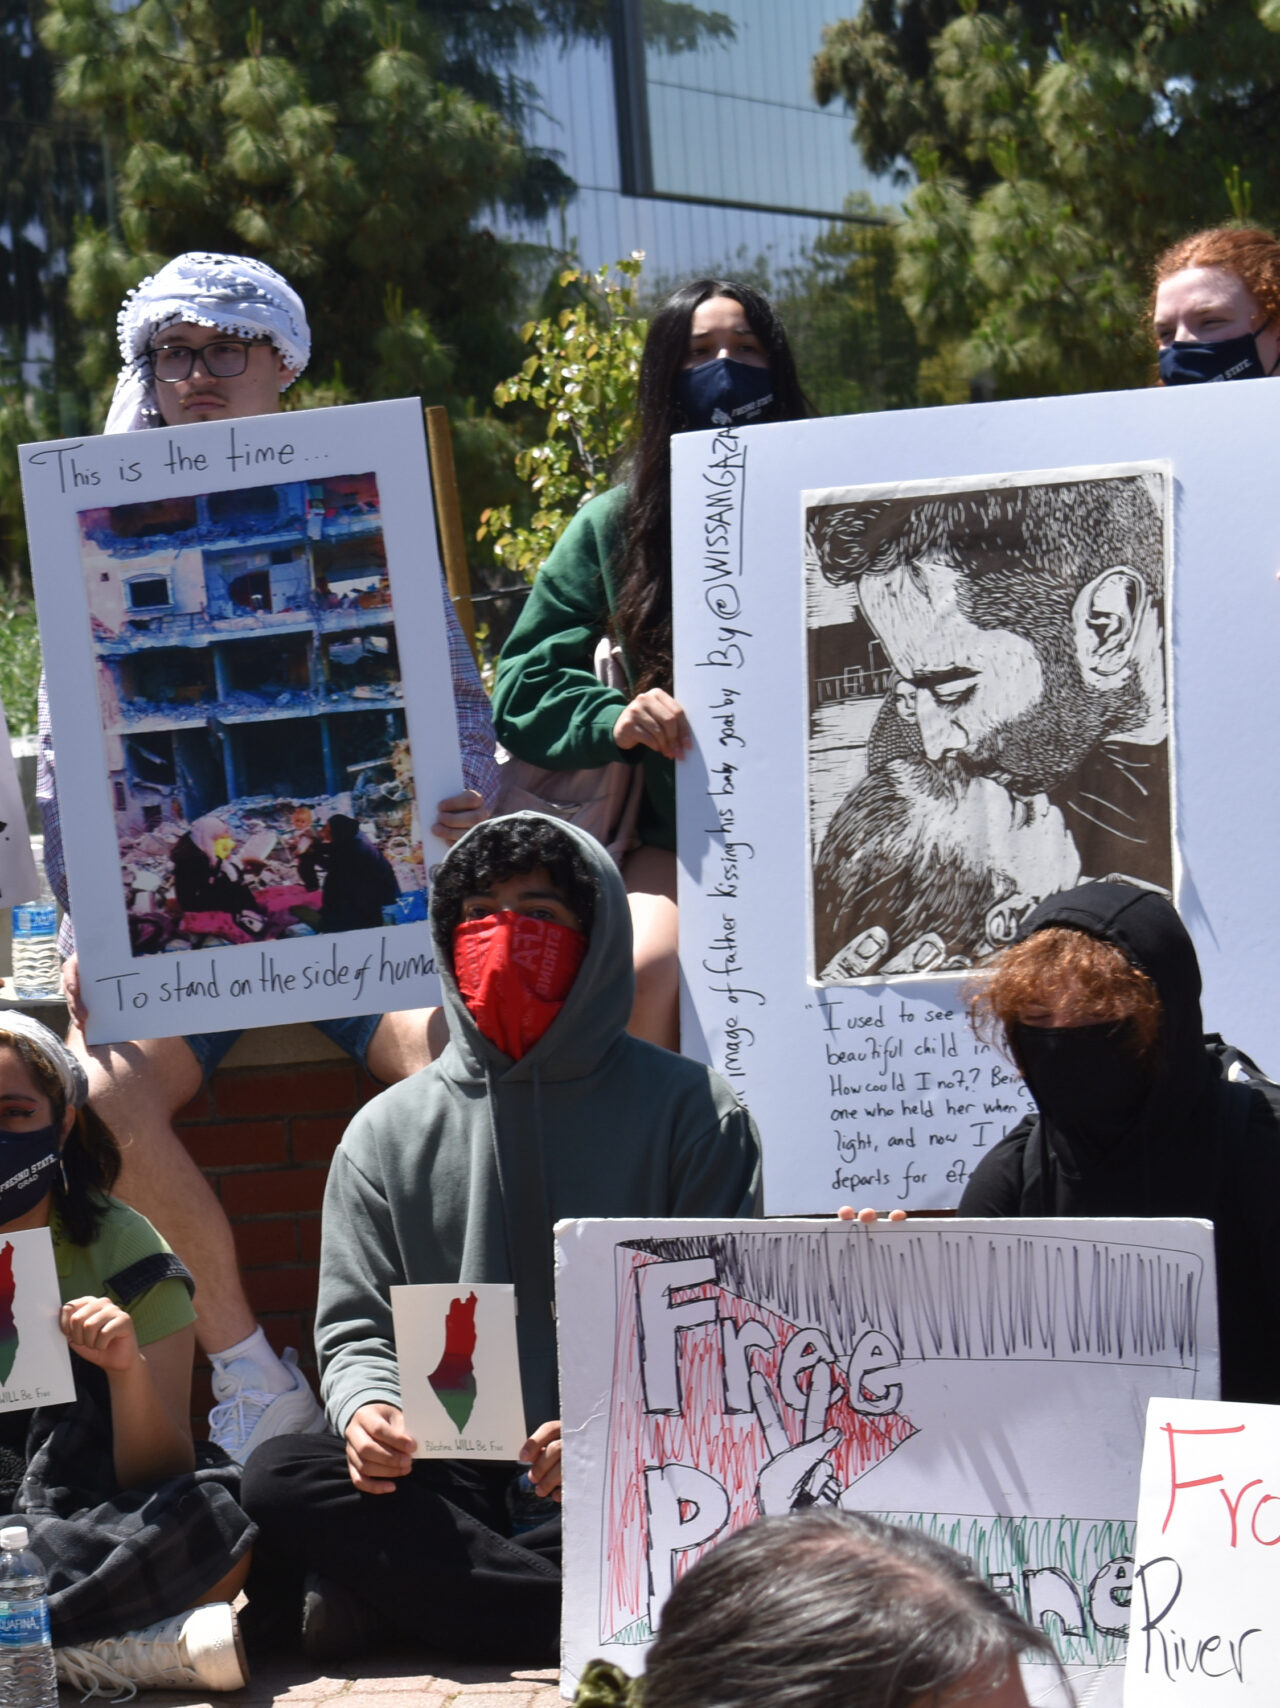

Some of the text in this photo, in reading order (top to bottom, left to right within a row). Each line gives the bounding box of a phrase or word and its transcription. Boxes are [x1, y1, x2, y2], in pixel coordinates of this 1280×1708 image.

[28, 443, 101, 494] This
[119, 458, 143, 482] is
[164, 439, 208, 475] the
[707, 762, 739, 796] baby
[704, 807, 735, 834] his
[702, 913, 743, 976] father
[95, 972, 149, 1011] To
[159, 959, 220, 1002] stand
[229, 978, 253, 997] on
[258, 951, 296, 994] the
[303, 942, 348, 990] side
[353, 953, 373, 1001] of
[379, 936, 440, 985] huma
[708, 985, 766, 1006] of
[847, 1005, 885, 1029] used
[898, 1000, 915, 1023] to
[924, 1009, 954, 1022] see
[826, 1032, 991, 1076] beautiful child in
[829, 1074, 861, 1096] How
[865, 1072, 906, 1092] could
[914, 1072, 931, 1091] I
[831, 1108, 858, 1121] one
[864, 1103, 895, 1117] who
[901, 1099, 935, 1118] held
[946, 1098, 976, 1115] her
[983, 1098, 1018, 1114] when
[834, 1130, 878, 1163] light,
[887, 1127, 916, 1148] and
[929, 1133, 957, 1145] now
[969, 1121, 994, 1147] I
[832, 1167, 890, 1193] departs
[897, 1160, 928, 1200] for
[634, 1256, 903, 1416] Free
[454, 1439, 475, 1451] WILL
[1135, 1556, 1263, 1683] River
